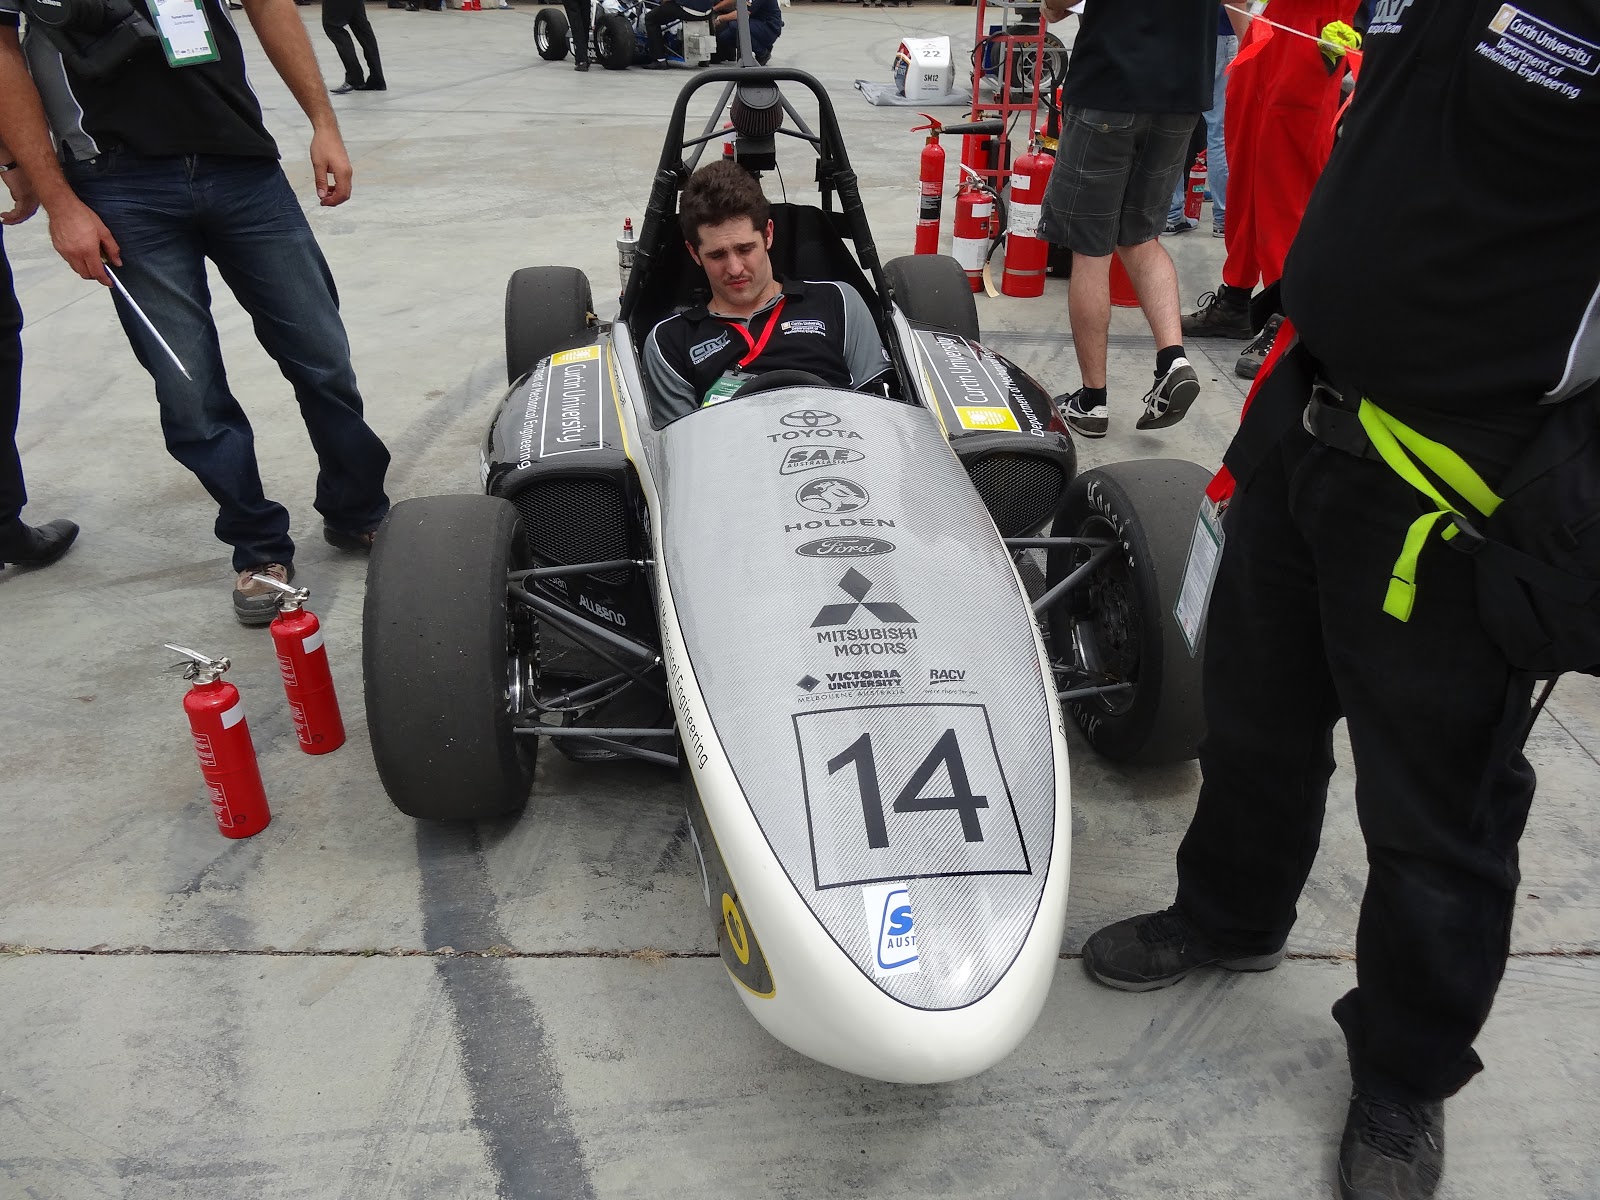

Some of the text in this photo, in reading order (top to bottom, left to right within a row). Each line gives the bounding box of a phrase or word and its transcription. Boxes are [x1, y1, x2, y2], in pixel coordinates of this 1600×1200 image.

[1510, 18, 1593, 66] Curtin University
[922, 50, 941, 58] 22
[1496, 37, 1566, 77] Department of
[923, 74, 939, 82] SM12
[1474, 41, 1581, 99] Mechanical Engineering
[935, 335, 989, 403] Curtin University
[556, 364, 587, 443] Curtin University
[1012, 392, 1045, 438] Department
[766, 428, 865, 443] TOYOTA
[517, 419, 539, 470] Engineering
[786, 460, 848, 469] AUSTRALASIA
[787, 449, 850, 464] SAE
[784, 518, 896, 533] HOLDEN
[816, 537, 876, 555] Ford
[816, 627, 918, 644] MITSUBISHI
[833, 642, 908, 658] MOTORS
[825, 669, 901, 682] VICTORIA
[929, 669, 966, 680] RACV
[827, 679, 902, 690] UNIVERSITY
[797, 688, 905, 703] MELBOURNE AUSTRALIA
[674, 674, 709, 770] Engineering
[827, 728, 990, 849] 14
[887, 905, 914, 936] S
[887, 935, 917, 949] AUST
